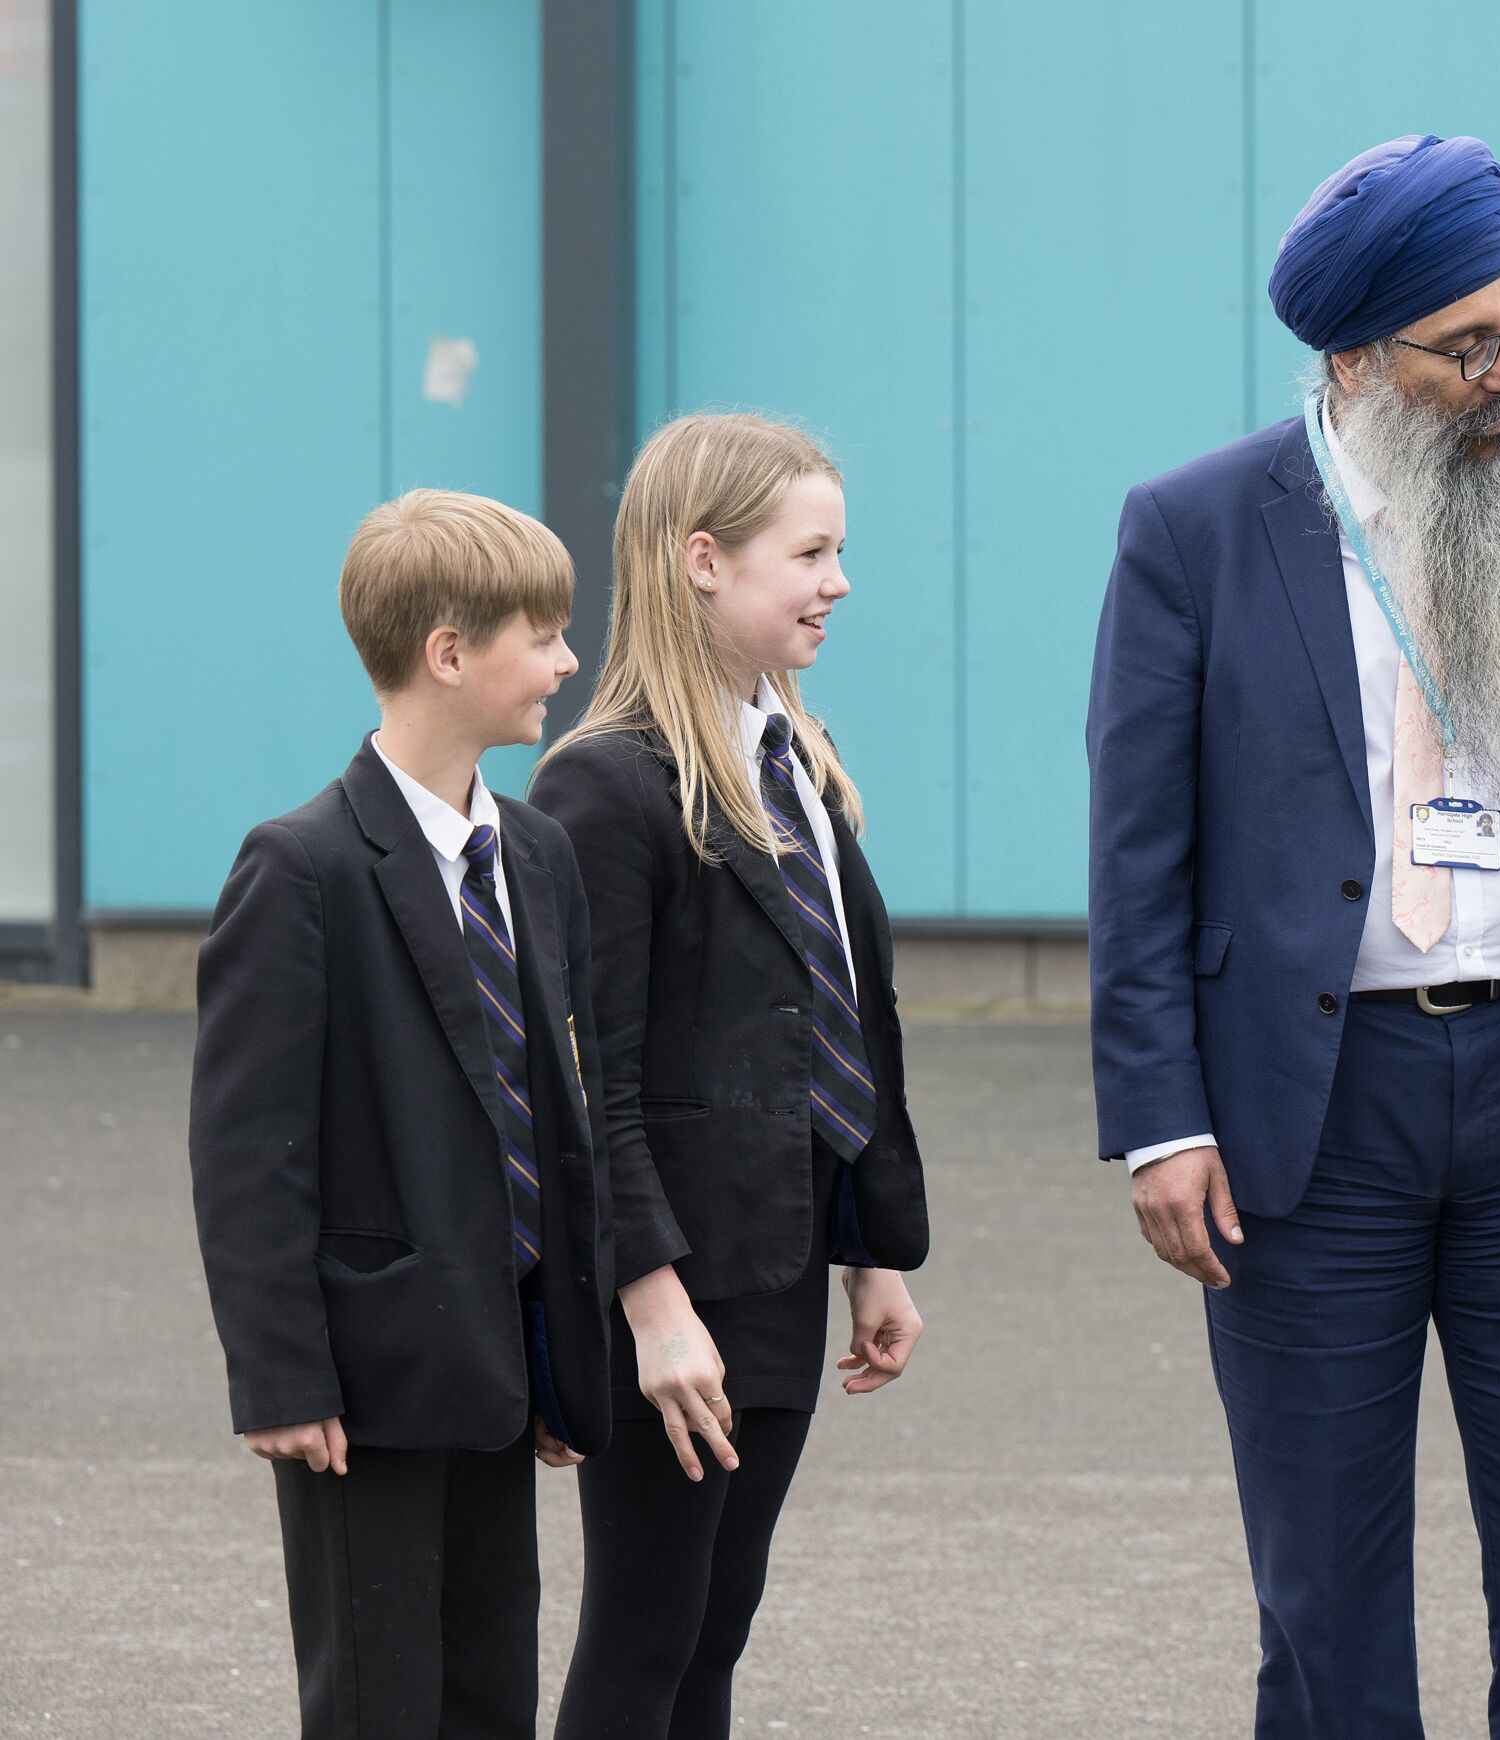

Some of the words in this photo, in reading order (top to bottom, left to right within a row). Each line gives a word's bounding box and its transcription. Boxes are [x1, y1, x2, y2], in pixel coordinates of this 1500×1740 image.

[1314, 440, 1325, 458] Star
[1363, 556, 1380, 582] Trust
[1379, 586, 1408, 637] Academies
